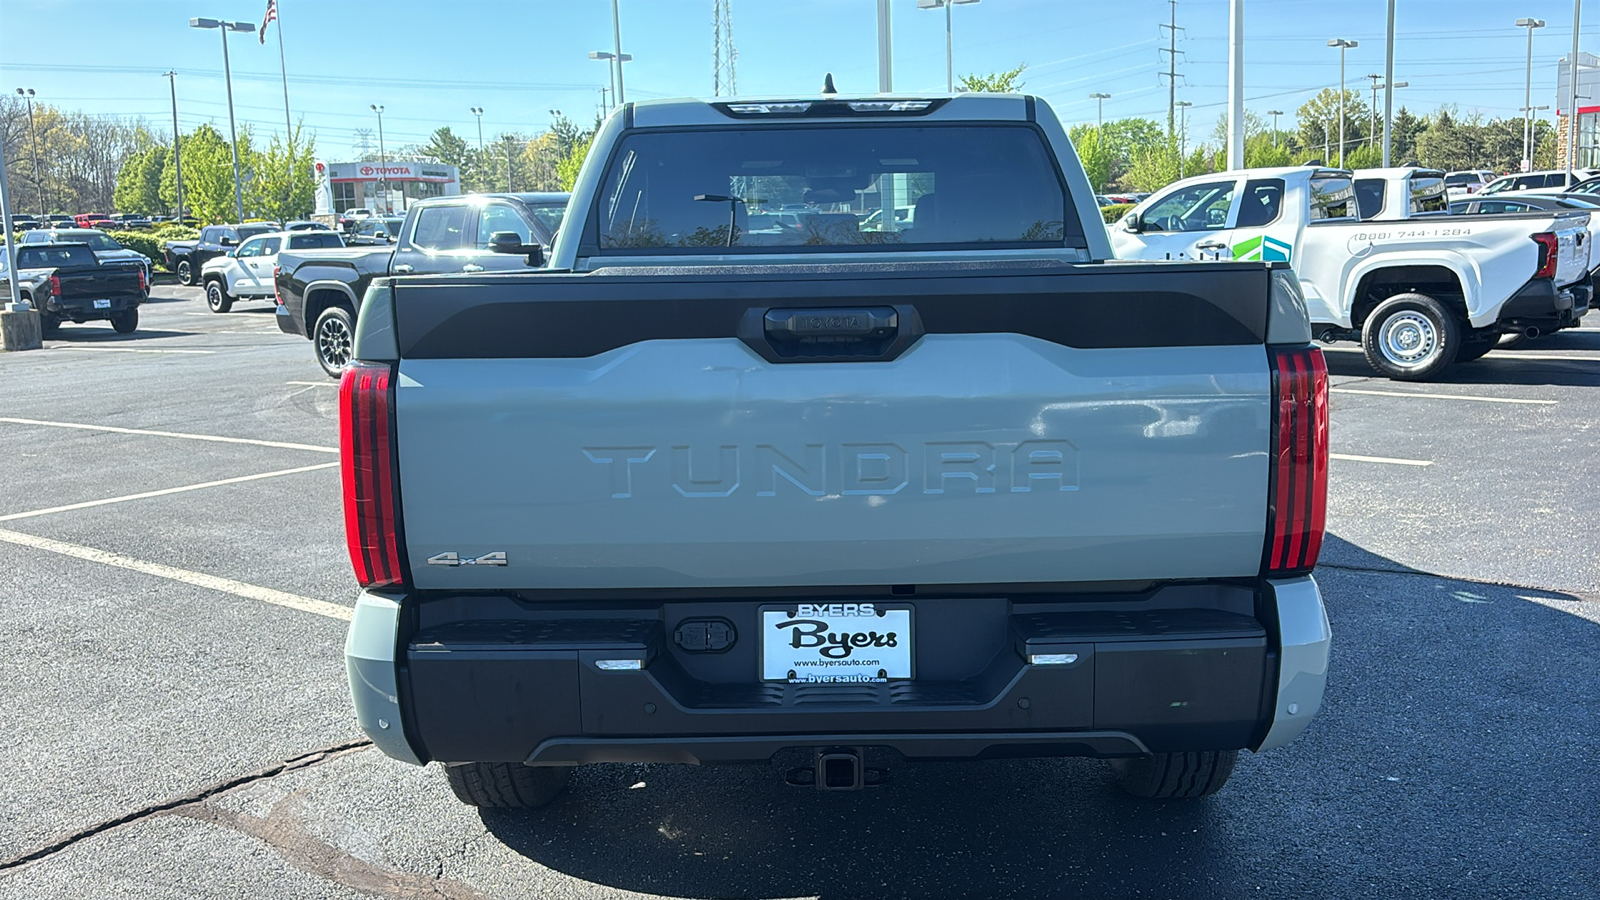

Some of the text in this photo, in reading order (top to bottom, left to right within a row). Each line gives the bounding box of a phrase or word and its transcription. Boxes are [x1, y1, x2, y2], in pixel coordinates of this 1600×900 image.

[374, 167, 410, 175] TOYOTA
[1354, 228, 1471, 241] (888) 744-1284
[801, 316, 861, 329] TOYOTA
[582, 439, 1080, 498] TUNDRA
[797, 603, 875, 617] BYERS
[775, 619, 898, 659] Byers
[794, 659, 880, 668] www.byersauto.com
[788, 674, 887, 684] www.byersauto.com
